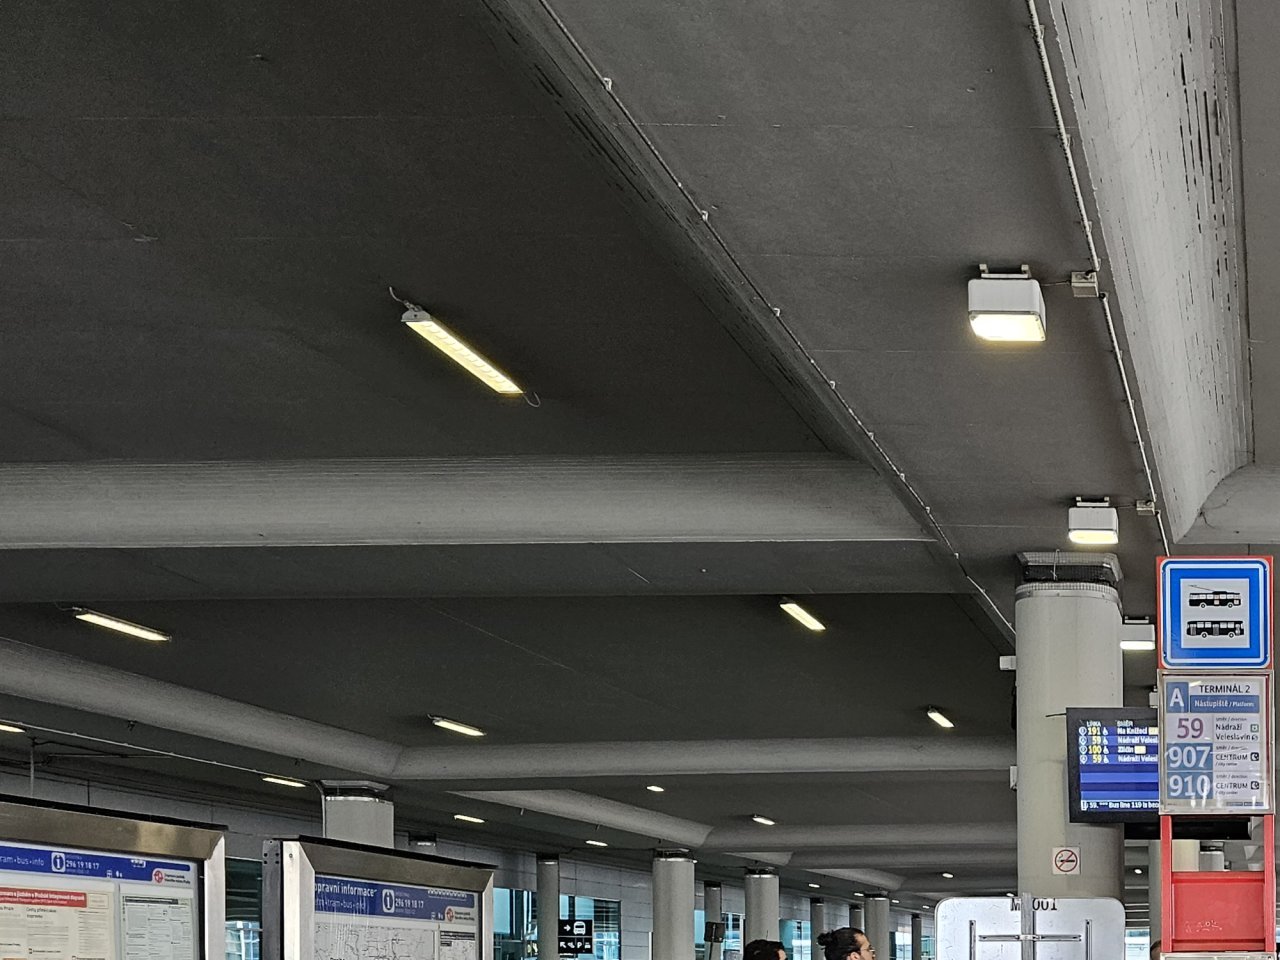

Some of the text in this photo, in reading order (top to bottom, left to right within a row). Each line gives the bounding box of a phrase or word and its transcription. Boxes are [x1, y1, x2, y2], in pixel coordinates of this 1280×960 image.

[1200, 683, 1250, 694] TERMINÁL 2
[1169, 687, 1185, 707] A
[1087, 726, 1101, 735] 191
[1177, 717, 1204, 739] 59
[1215, 723, 1243, 731] Nádraží
[1092, 736, 1101, 745] 59
[1215, 733, 1250, 741] Veleslavín
[1088, 745, 1102, 754] 100
[1092, 754, 1102, 763] 59
[1168, 745, 1211, 768] 907
[1169, 774, 1211, 797] 910
[0, 855, 14, 863] ram
[315, 881, 341, 895] opravní
